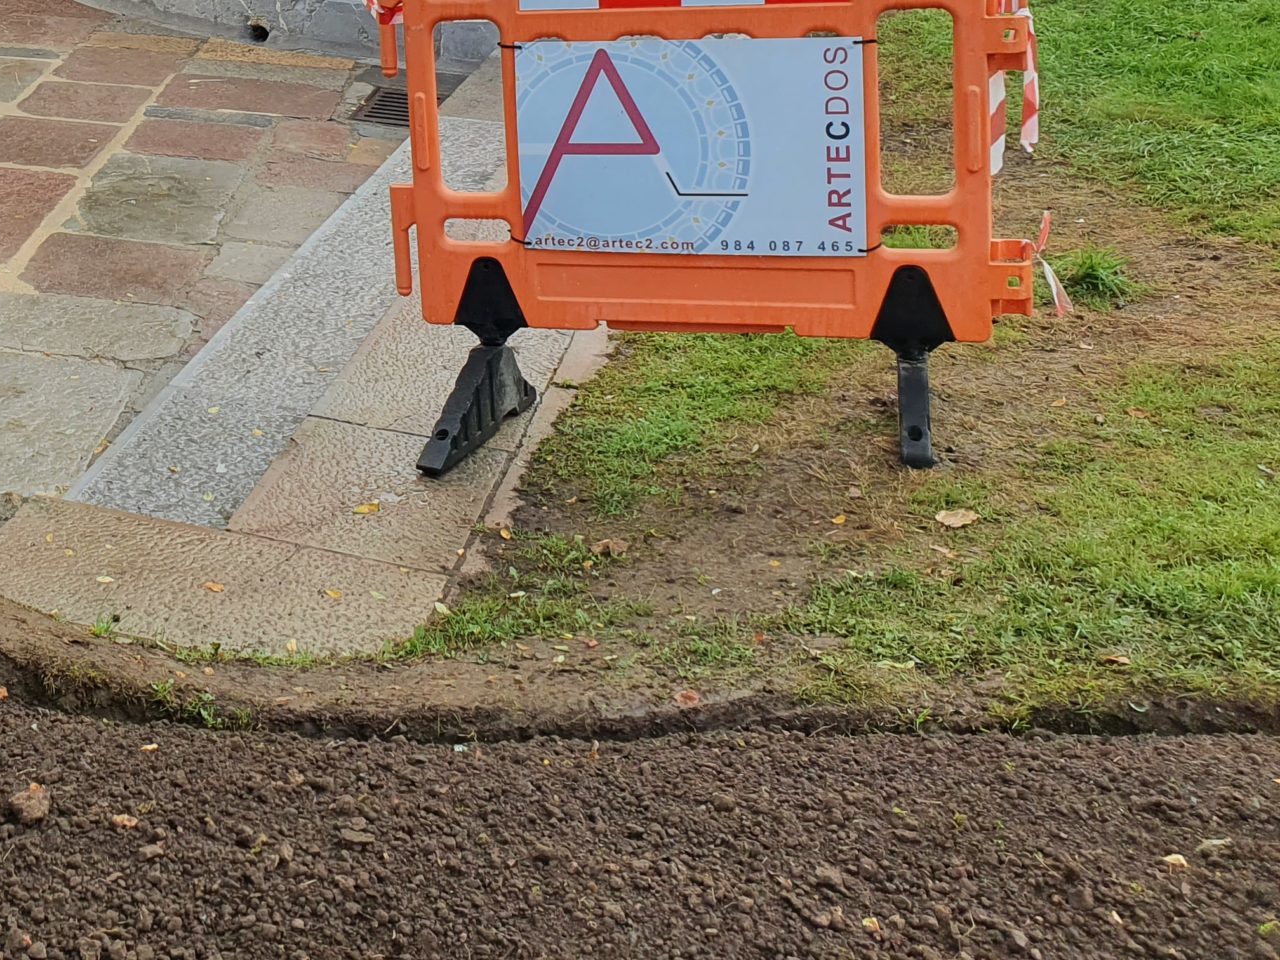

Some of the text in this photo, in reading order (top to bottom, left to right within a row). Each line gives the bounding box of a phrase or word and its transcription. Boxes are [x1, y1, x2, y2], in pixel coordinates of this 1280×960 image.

[823, 46, 853, 233] ARTECDOS
[535, 235, 695, 251] artec2@artec2.com
[720, 239, 855, 253] 984 087 465
